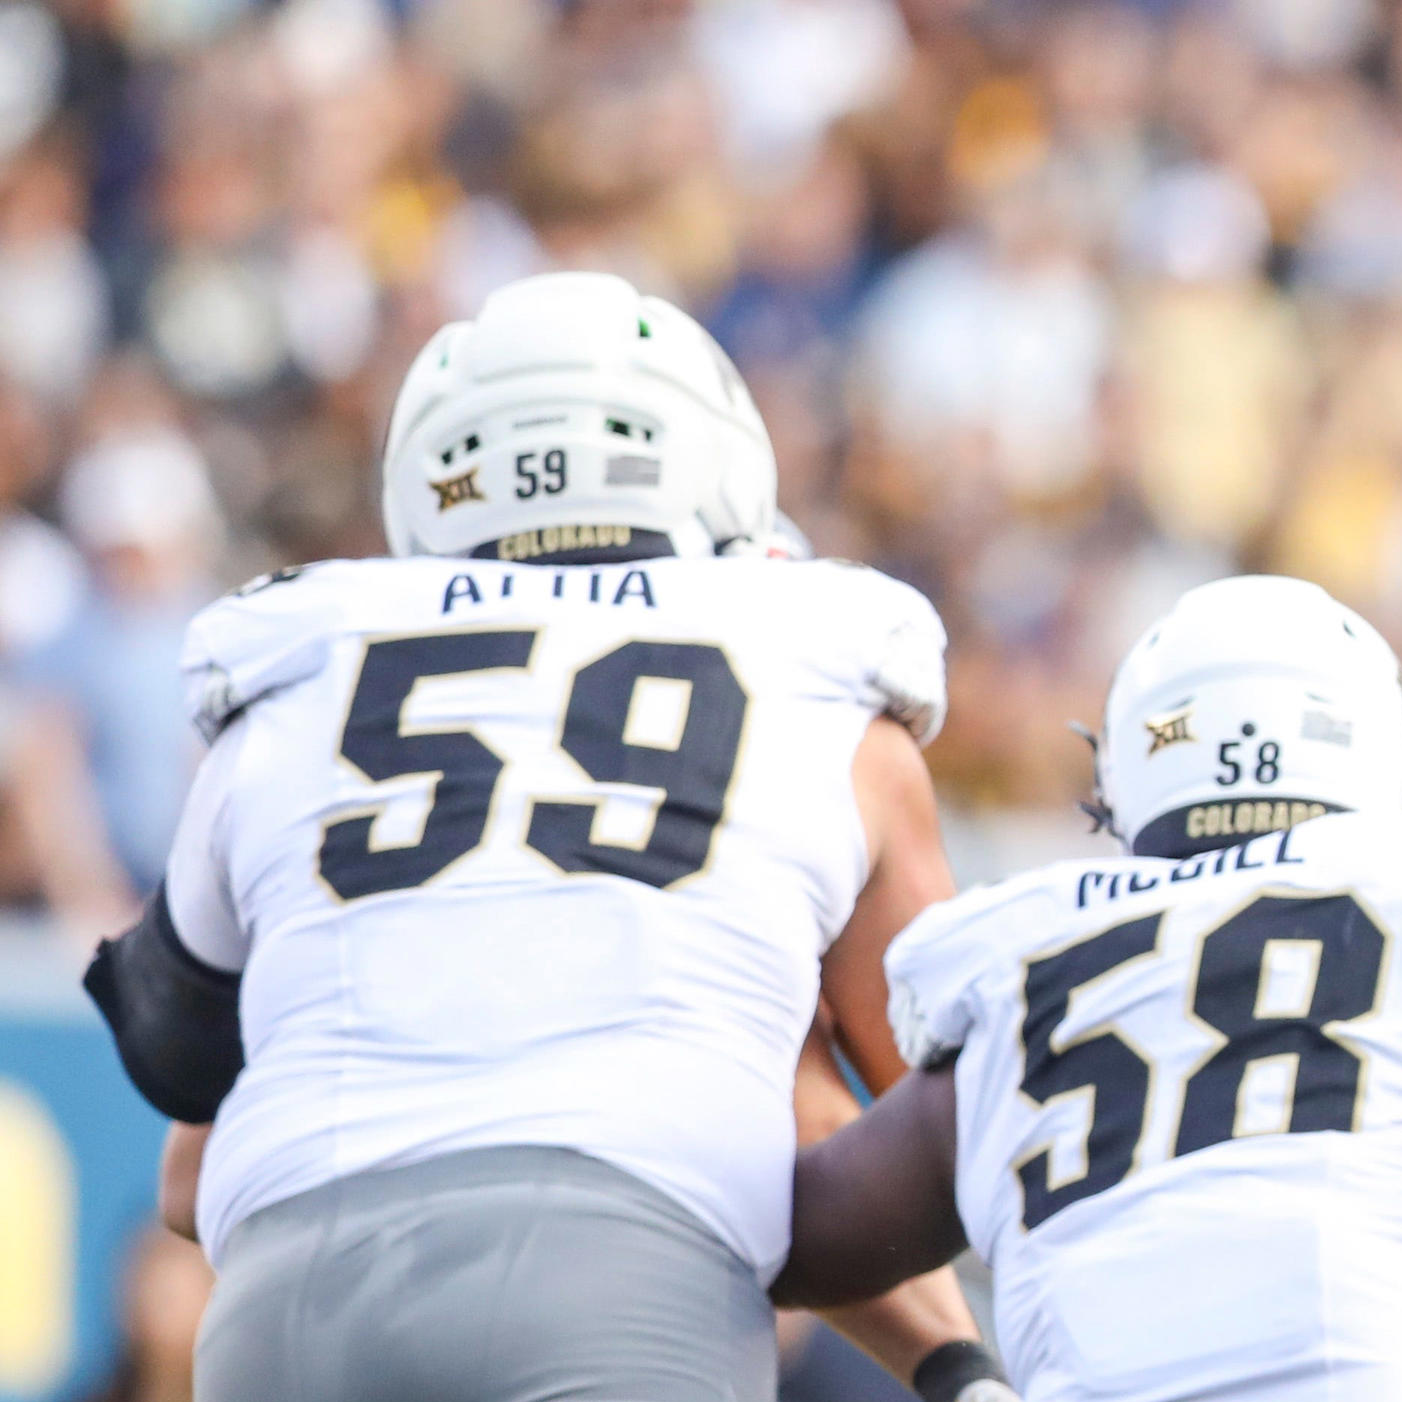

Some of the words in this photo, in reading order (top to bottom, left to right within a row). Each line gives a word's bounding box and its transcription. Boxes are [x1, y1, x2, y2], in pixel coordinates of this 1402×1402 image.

[514, 449, 568, 499] 59
[497, 525, 631, 561] COLORADO
[315, 624, 754, 905] 59
[1216, 742, 1281, 786] 58
[1009, 884, 1395, 1234] 58
